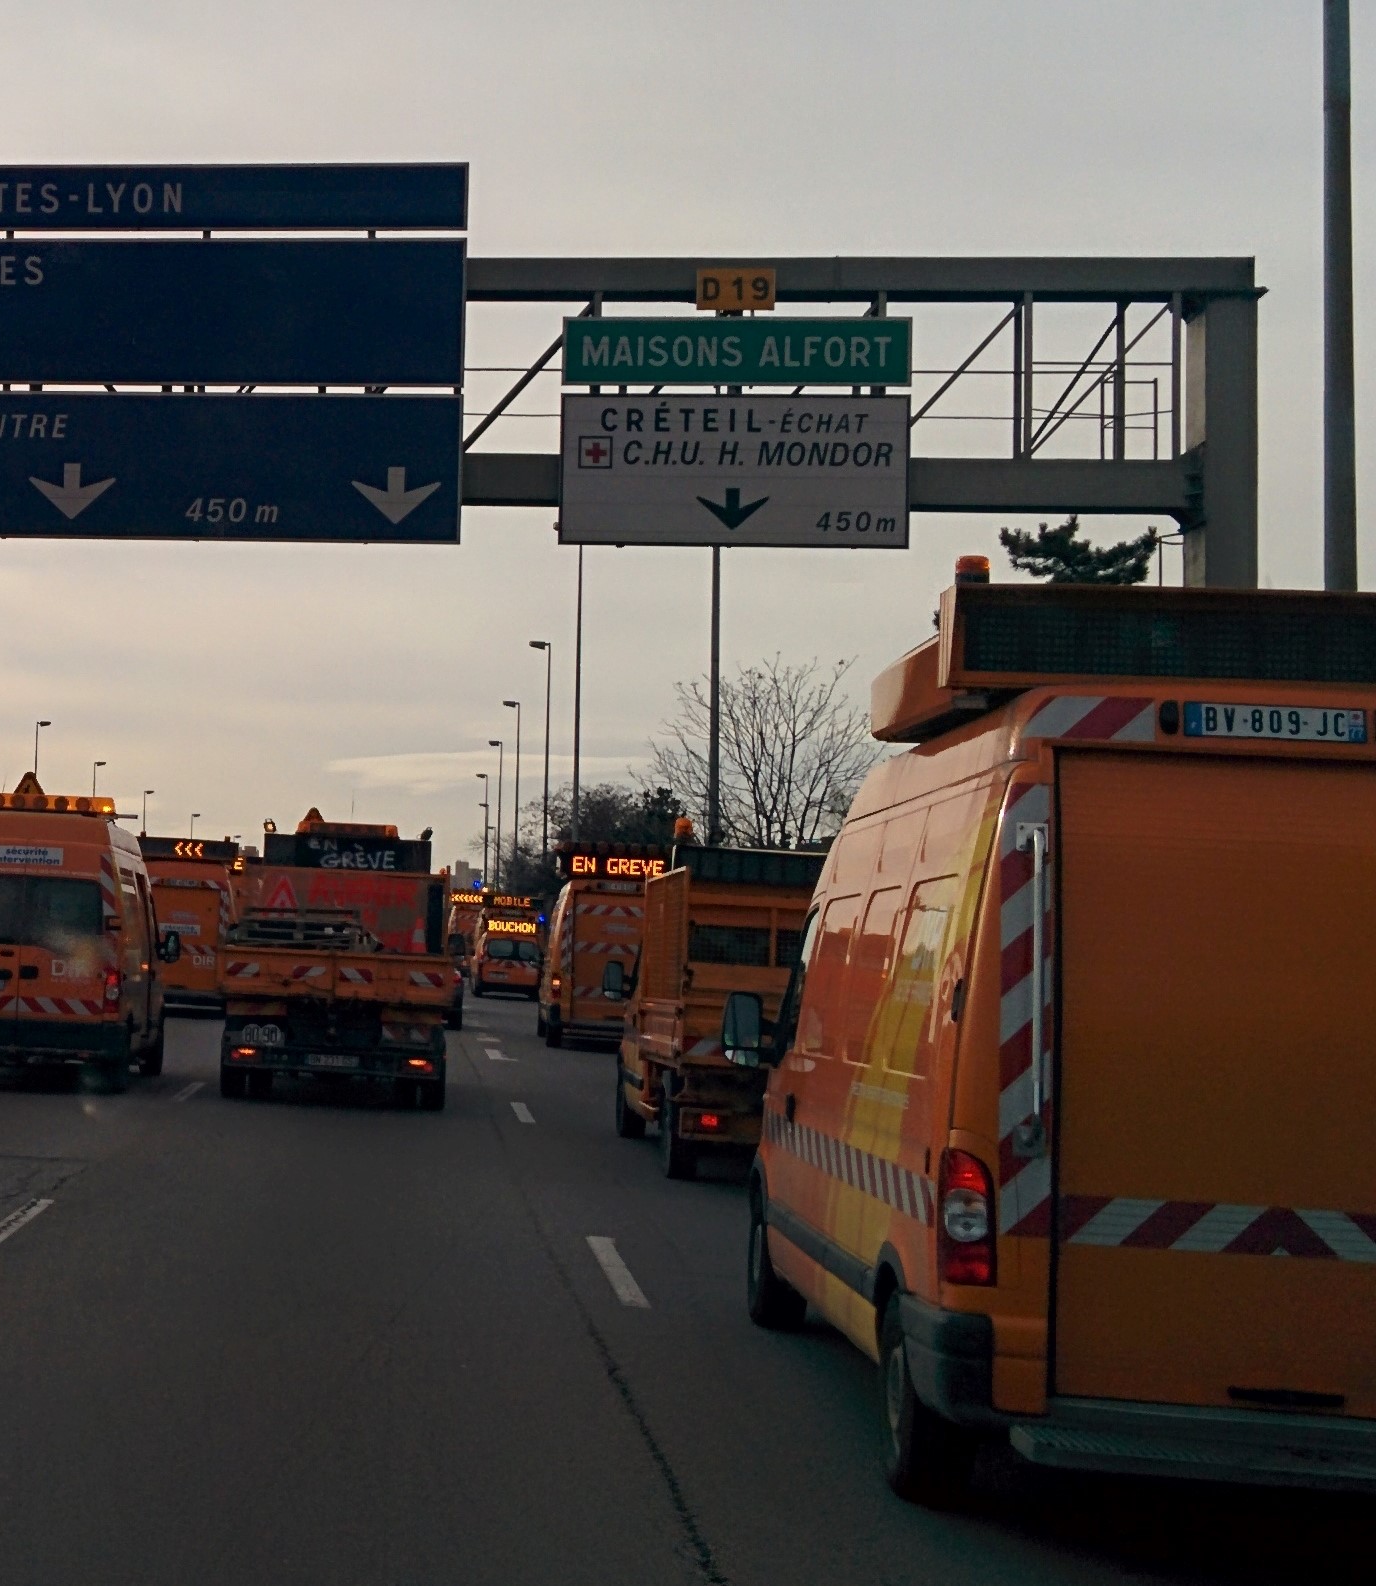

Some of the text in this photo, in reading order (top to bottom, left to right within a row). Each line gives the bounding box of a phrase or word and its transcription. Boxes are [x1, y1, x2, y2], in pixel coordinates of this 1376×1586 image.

[702, 275, 771, 302] D 19
[581, 334, 892, 368] MAISONS ALFORT
[599, 401, 869, 434] CRÉTEIL-ÉCHAT
[622, 440, 894, 468] C.H.U. H. MONDOR
[184, 497, 279, 523] 450 m
[5, 846, 49, 857] sécurité
[308, 836, 338, 852] EN
[320, 843, 396, 870] GRÈVE
[571, 855, 665, 877] EN GREVE
[493, 895, 531, 908] MOBILE
[487, 919, 536, 934] BOUCHON
[261, 1027, 279, 1043] 90
